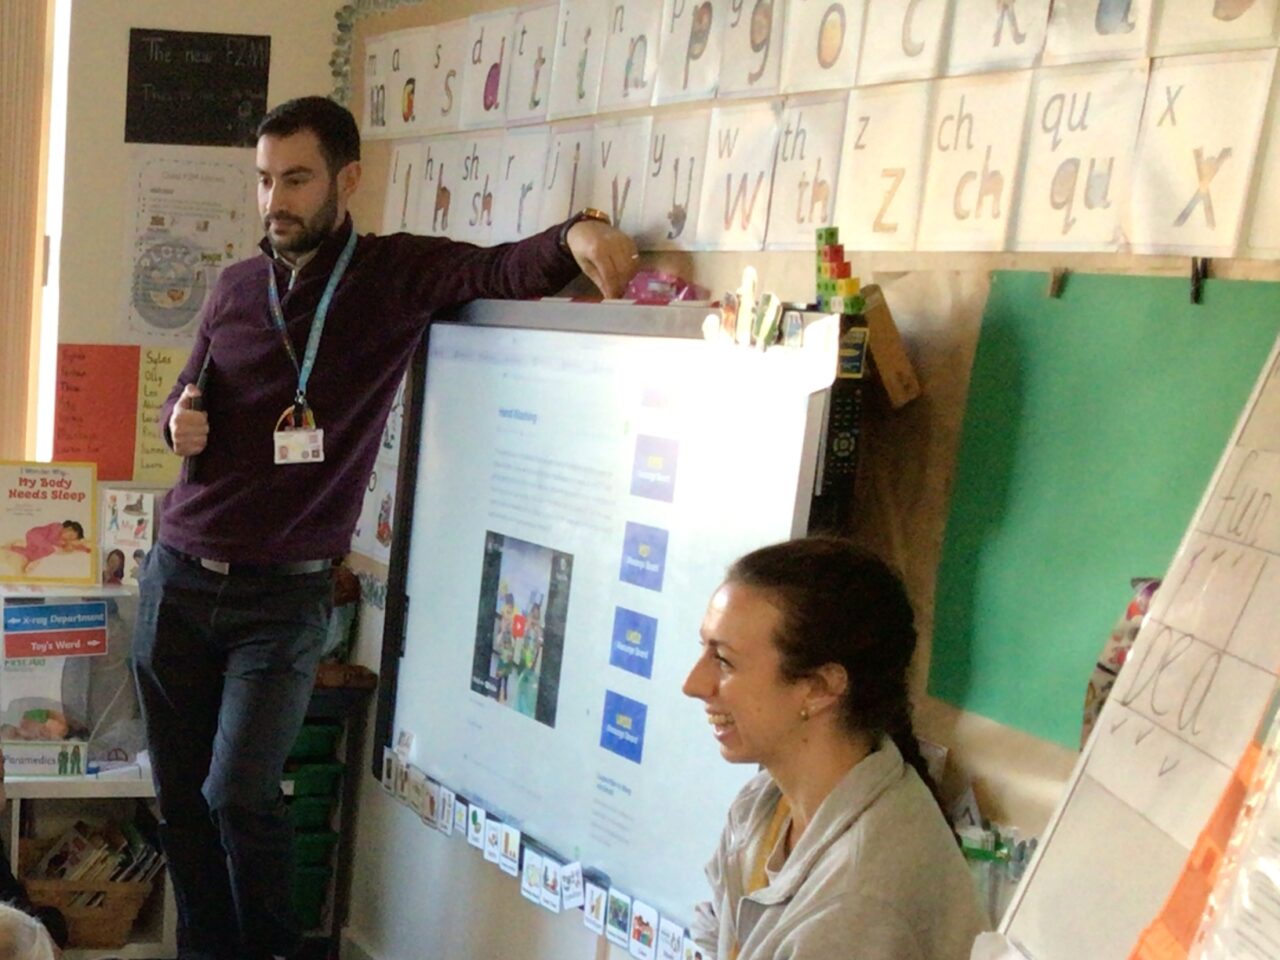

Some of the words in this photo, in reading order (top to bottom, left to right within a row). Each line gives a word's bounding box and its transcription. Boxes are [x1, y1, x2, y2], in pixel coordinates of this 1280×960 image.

[781, 111, 807, 162] th
[937, 94, 974, 152] ch
[1041, 91, 1091, 152] qu
[424, 146, 433, 181] h
[462, 143, 480, 181] sh
[505, 155, 515, 180] r
[652, 134, 666, 177] y
[432, 163, 451, 232] h
[470, 174, 493, 226] sh
[796, 157, 830, 224] th
[953, 145, 1004, 220] ch
[1050, 156, 1115, 235] qu
[8, 489, 47, 499] Needs
[51, 489, 86, 502] Sleep
[18, 477, 36, 488] My
[40, 477, 72, 490] Body
[22, 615, 48, 626] X-ray
[50, 613, 104, 624] Department
[56, 639, 81, 649] Ward
